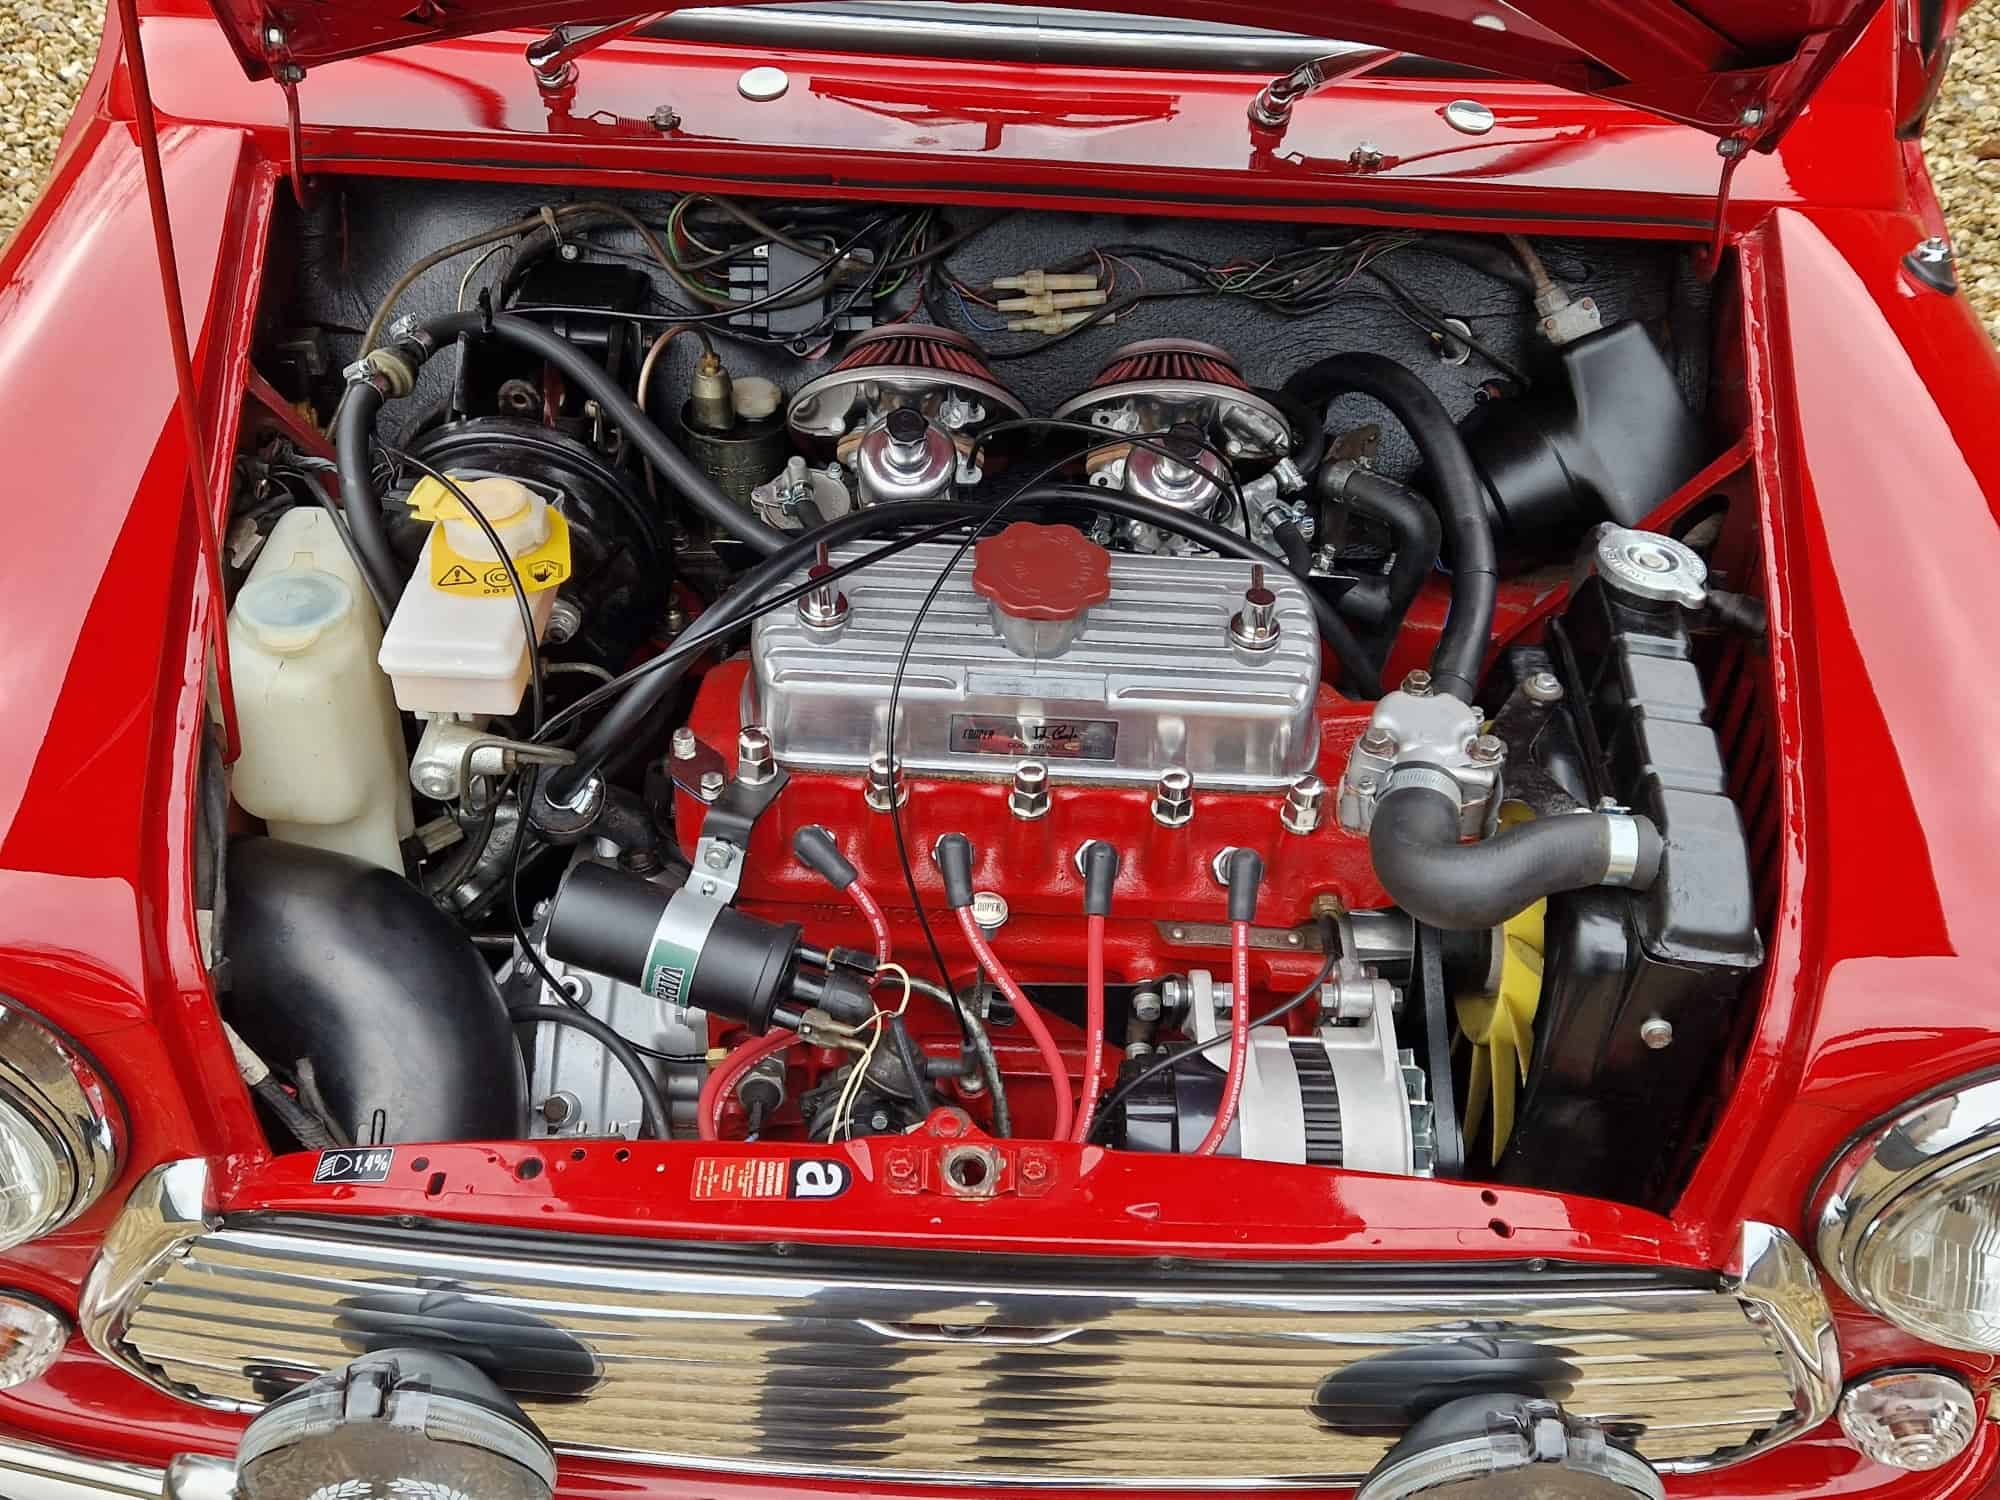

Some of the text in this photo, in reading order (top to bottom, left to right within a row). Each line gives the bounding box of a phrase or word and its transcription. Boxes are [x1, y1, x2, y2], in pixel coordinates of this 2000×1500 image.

[1238, 951, 1247, 996] SILICONE
[354, 1153, 388, 1174] 1,4%
[796, 1161, 843, 1197] a
